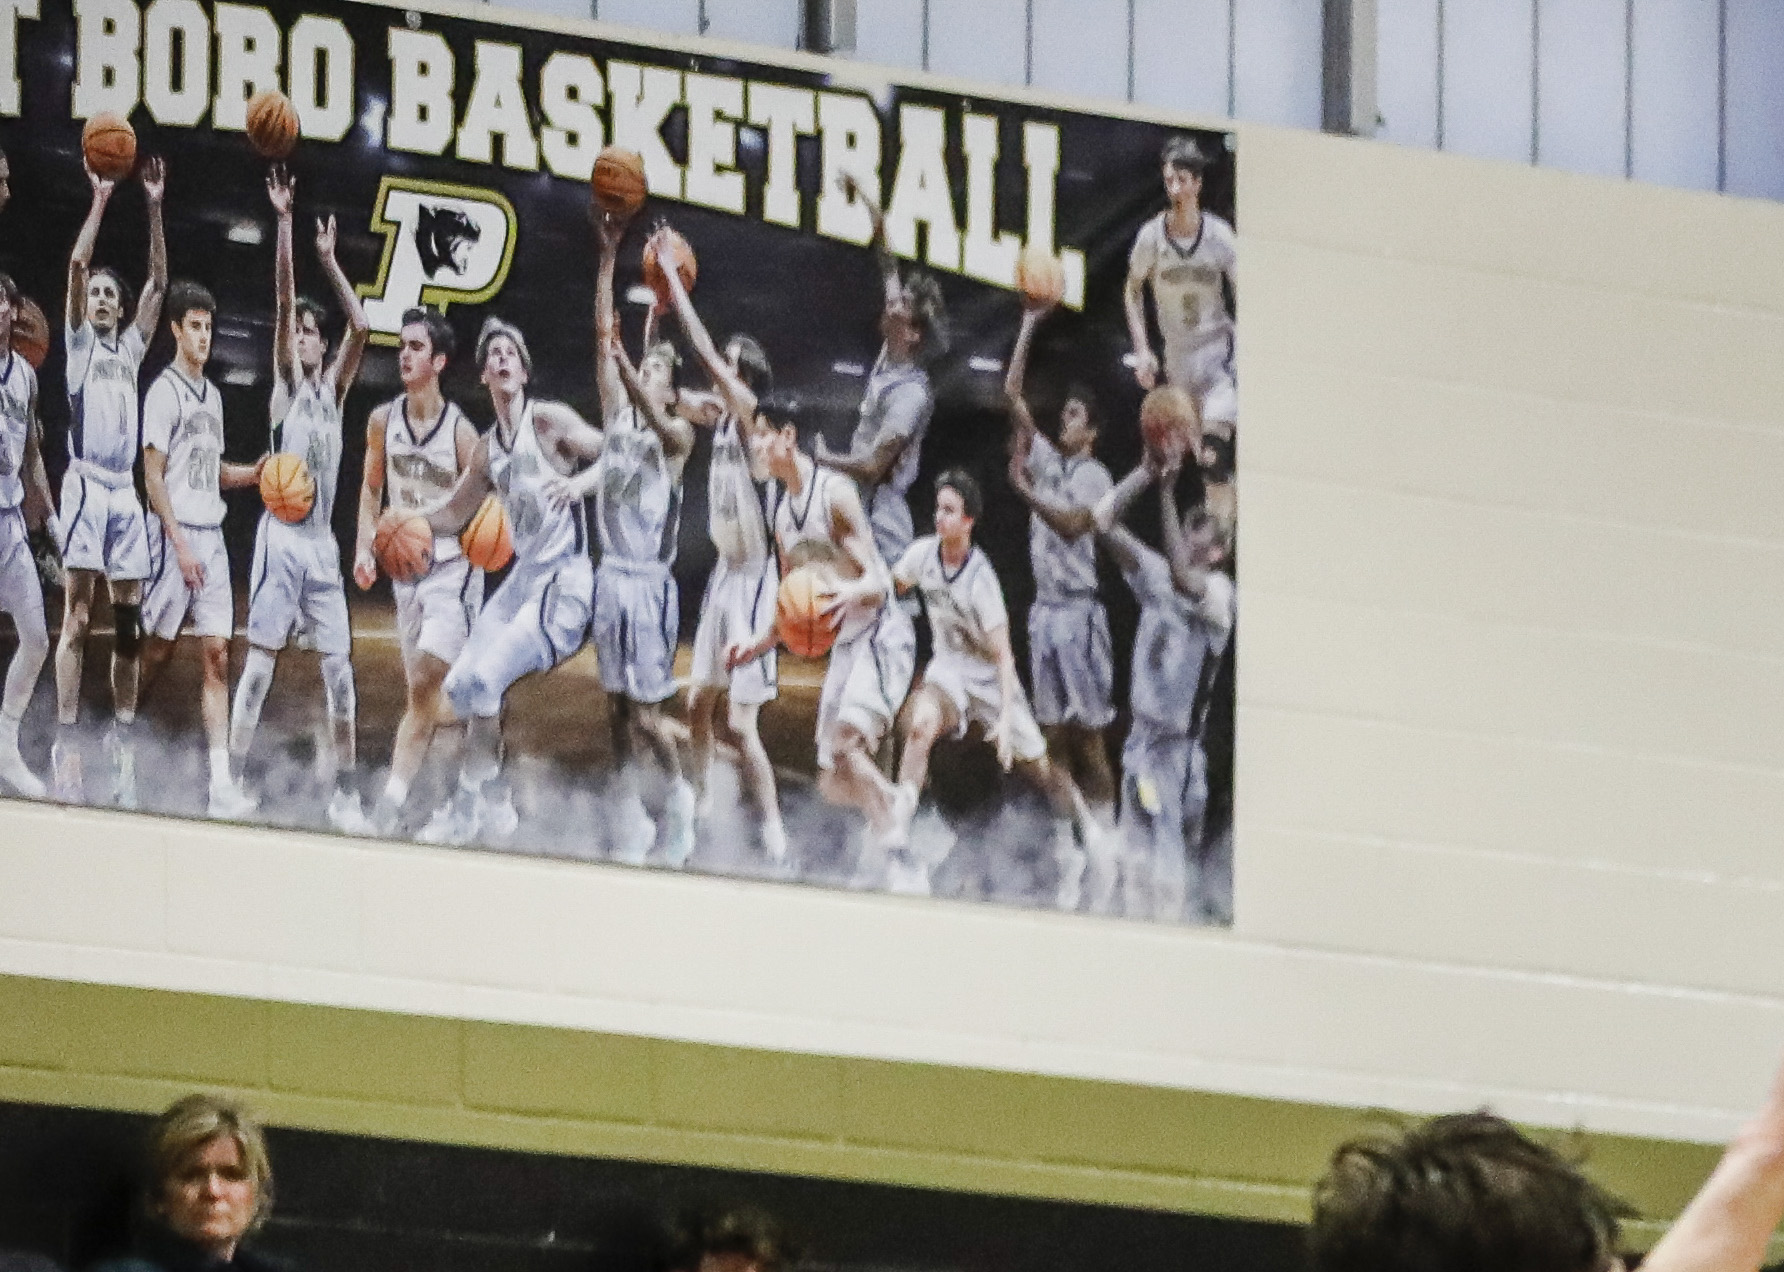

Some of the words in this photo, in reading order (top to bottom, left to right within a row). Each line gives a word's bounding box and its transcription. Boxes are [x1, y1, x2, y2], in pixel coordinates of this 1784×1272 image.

[71, 0, 355, 142] BORO
[386, 26, 1086, 310] BASKETBALL
[355, 174, 518, 348] P
